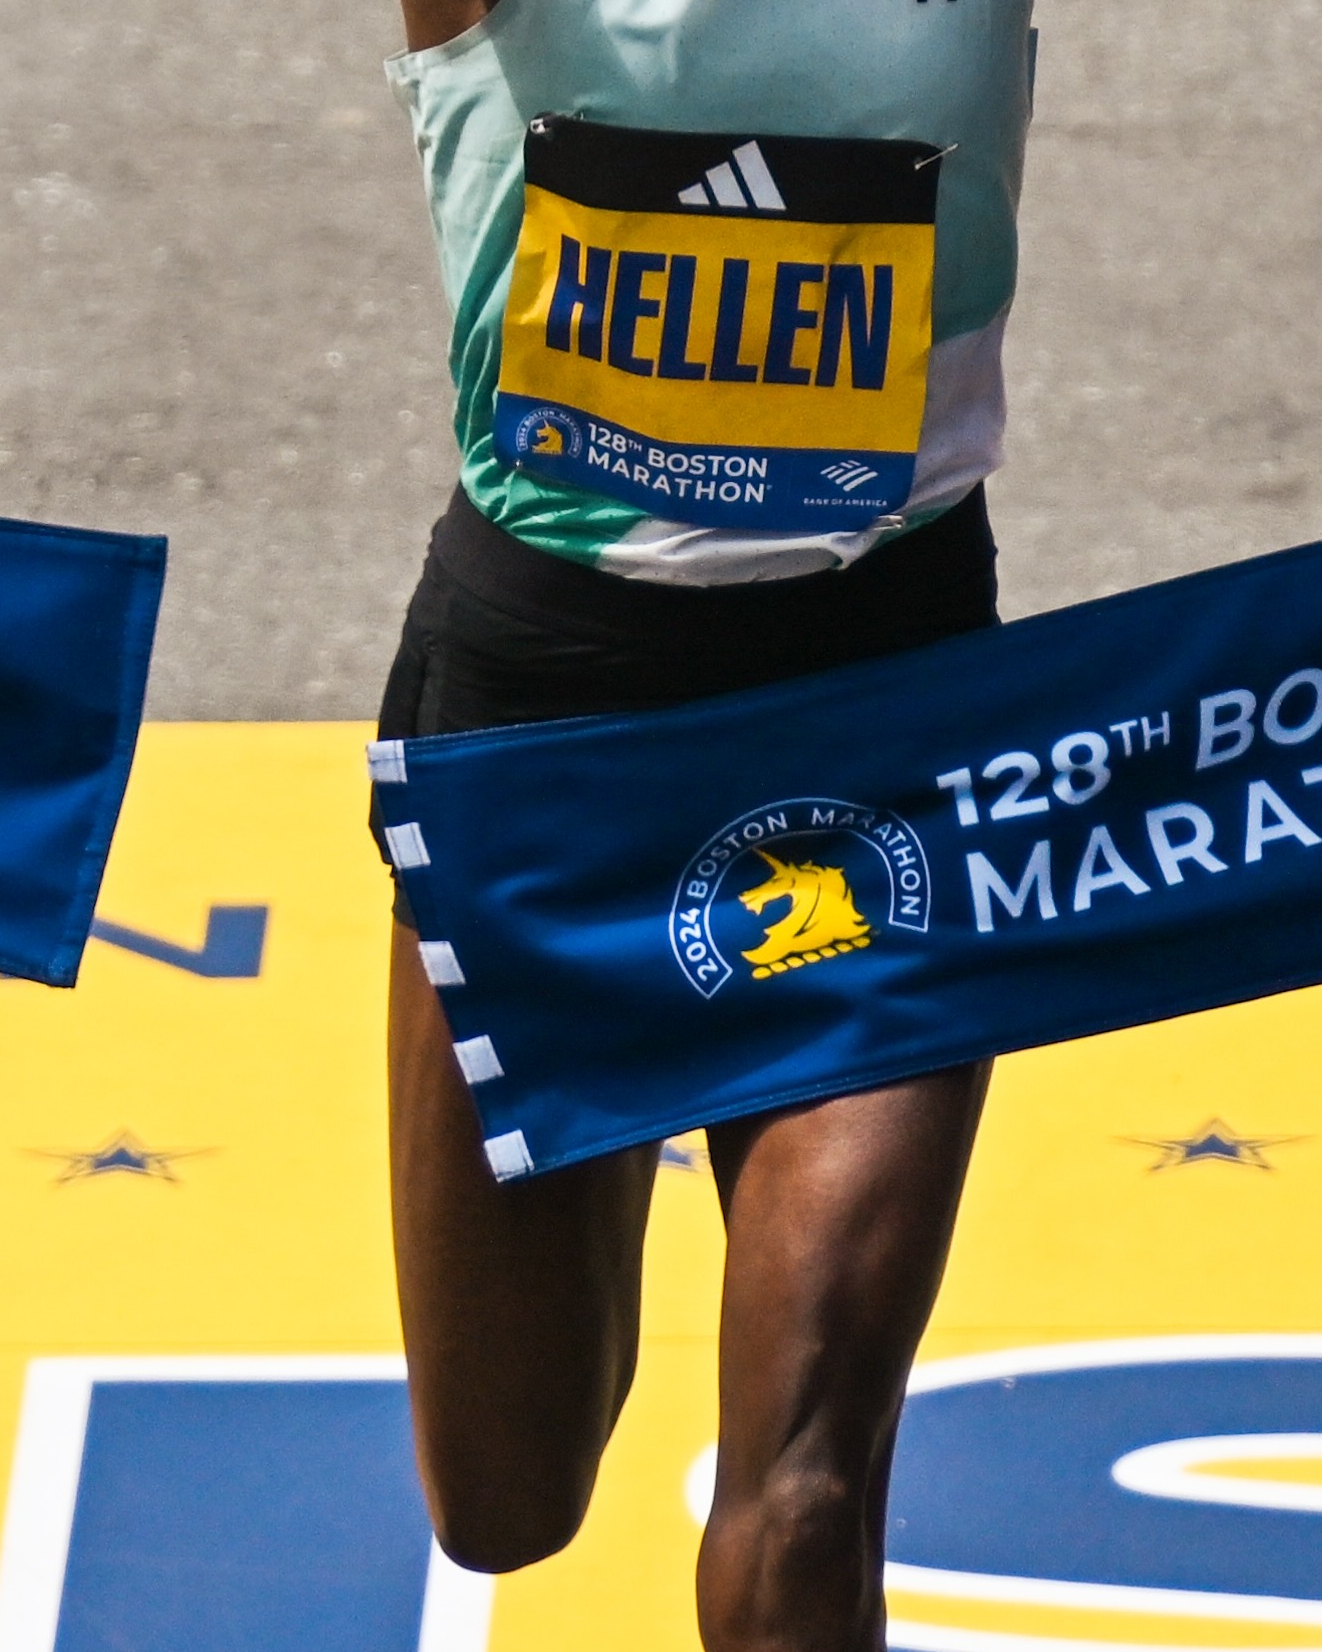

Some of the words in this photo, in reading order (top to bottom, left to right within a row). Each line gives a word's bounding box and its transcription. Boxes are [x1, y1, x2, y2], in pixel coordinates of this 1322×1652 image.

[545, 233, 894, 391] HELLEN
[587, 422, 643, 454] 128TH
[647, 446, 768, 479] BOSTON
[587, 445, 765, 504] MARATHON
[936, 710, 1171, 827] 128TH
[686, 811, 789, 899] BOSTON
[810, 807, 922, 916] MARATHON
[679, 907, 719, 982] 2024
